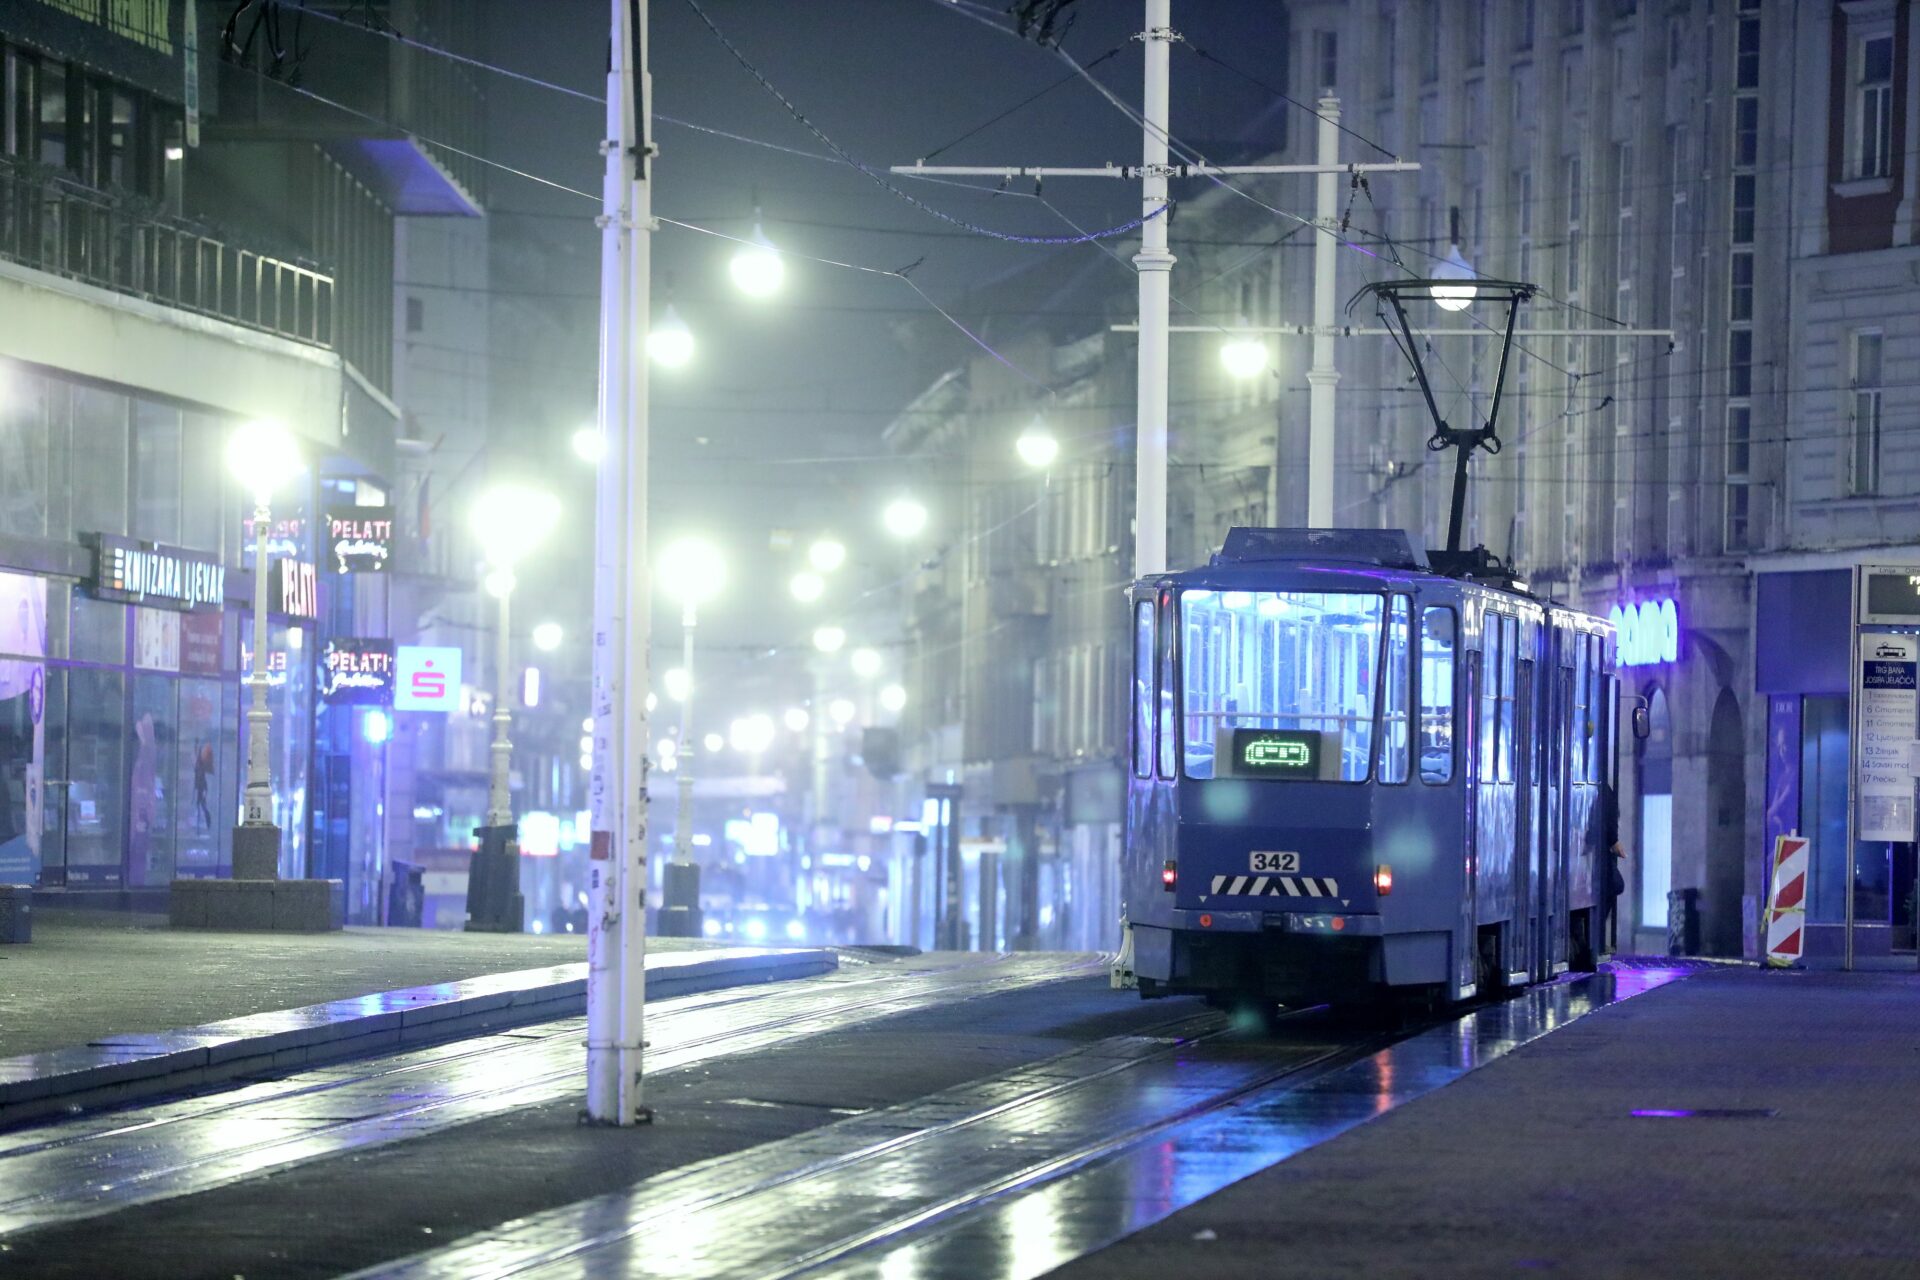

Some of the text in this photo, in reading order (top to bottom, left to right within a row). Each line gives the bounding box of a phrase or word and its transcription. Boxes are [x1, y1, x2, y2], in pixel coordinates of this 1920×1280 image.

[332, 520, 392, 539] PELATI
[125, 541, 225, 609] KNJIŽARA LJEVAK
[281, 558, 317, 618] PELATI
[329, 652, 389, 672] PELATI
[1862, 760, 1870, 768] 14
[1863, 774, 1871, 783] 17
[1254, 853, 1295, 870] 342
